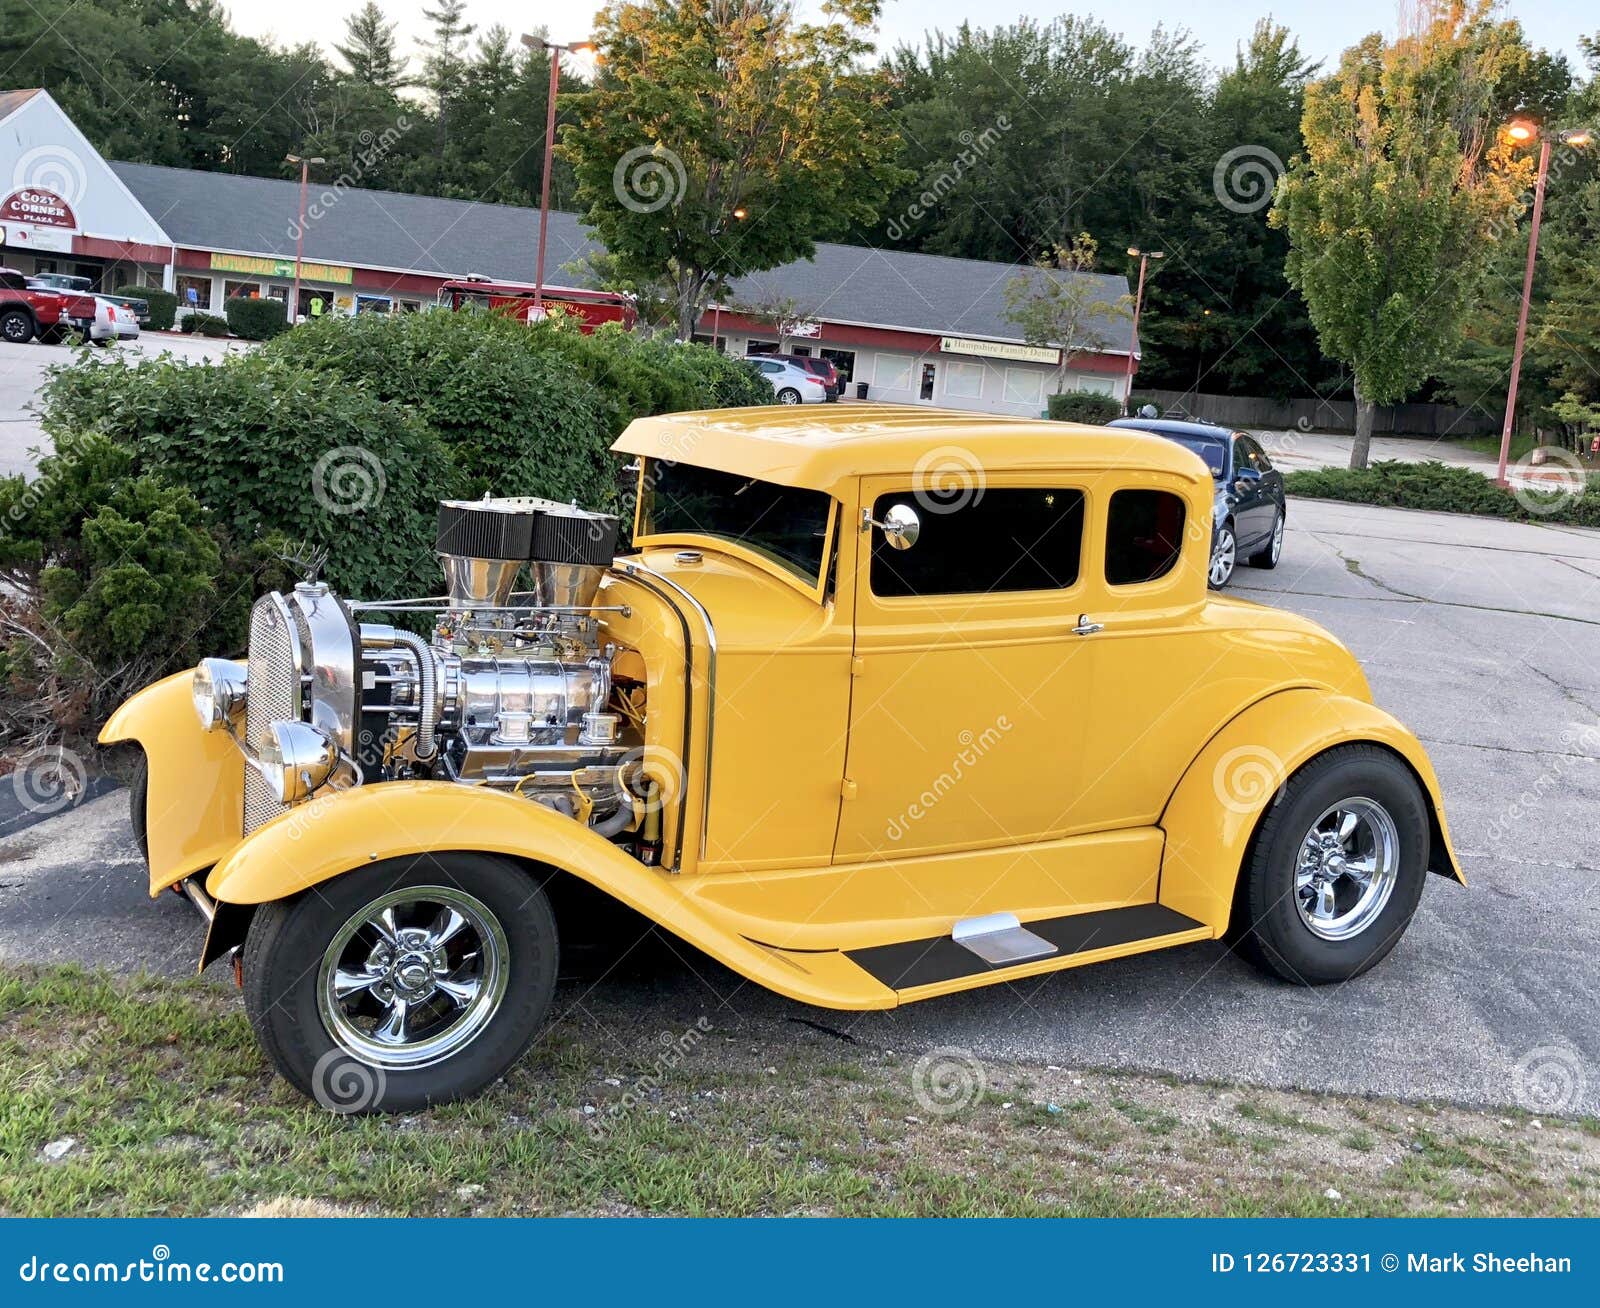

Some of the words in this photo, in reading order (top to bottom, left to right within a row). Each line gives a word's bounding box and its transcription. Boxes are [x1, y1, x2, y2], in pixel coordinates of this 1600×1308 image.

[21, 191, 56, 205] COZY
[10, 200, 64, 217] CORNER
[23, 214, 53, 223] PLAZA
[954, 340, 997, 353] Hampshire
[1000, 345, 1028, 356] Family
[1030, 349, 1058, 358] Dental
